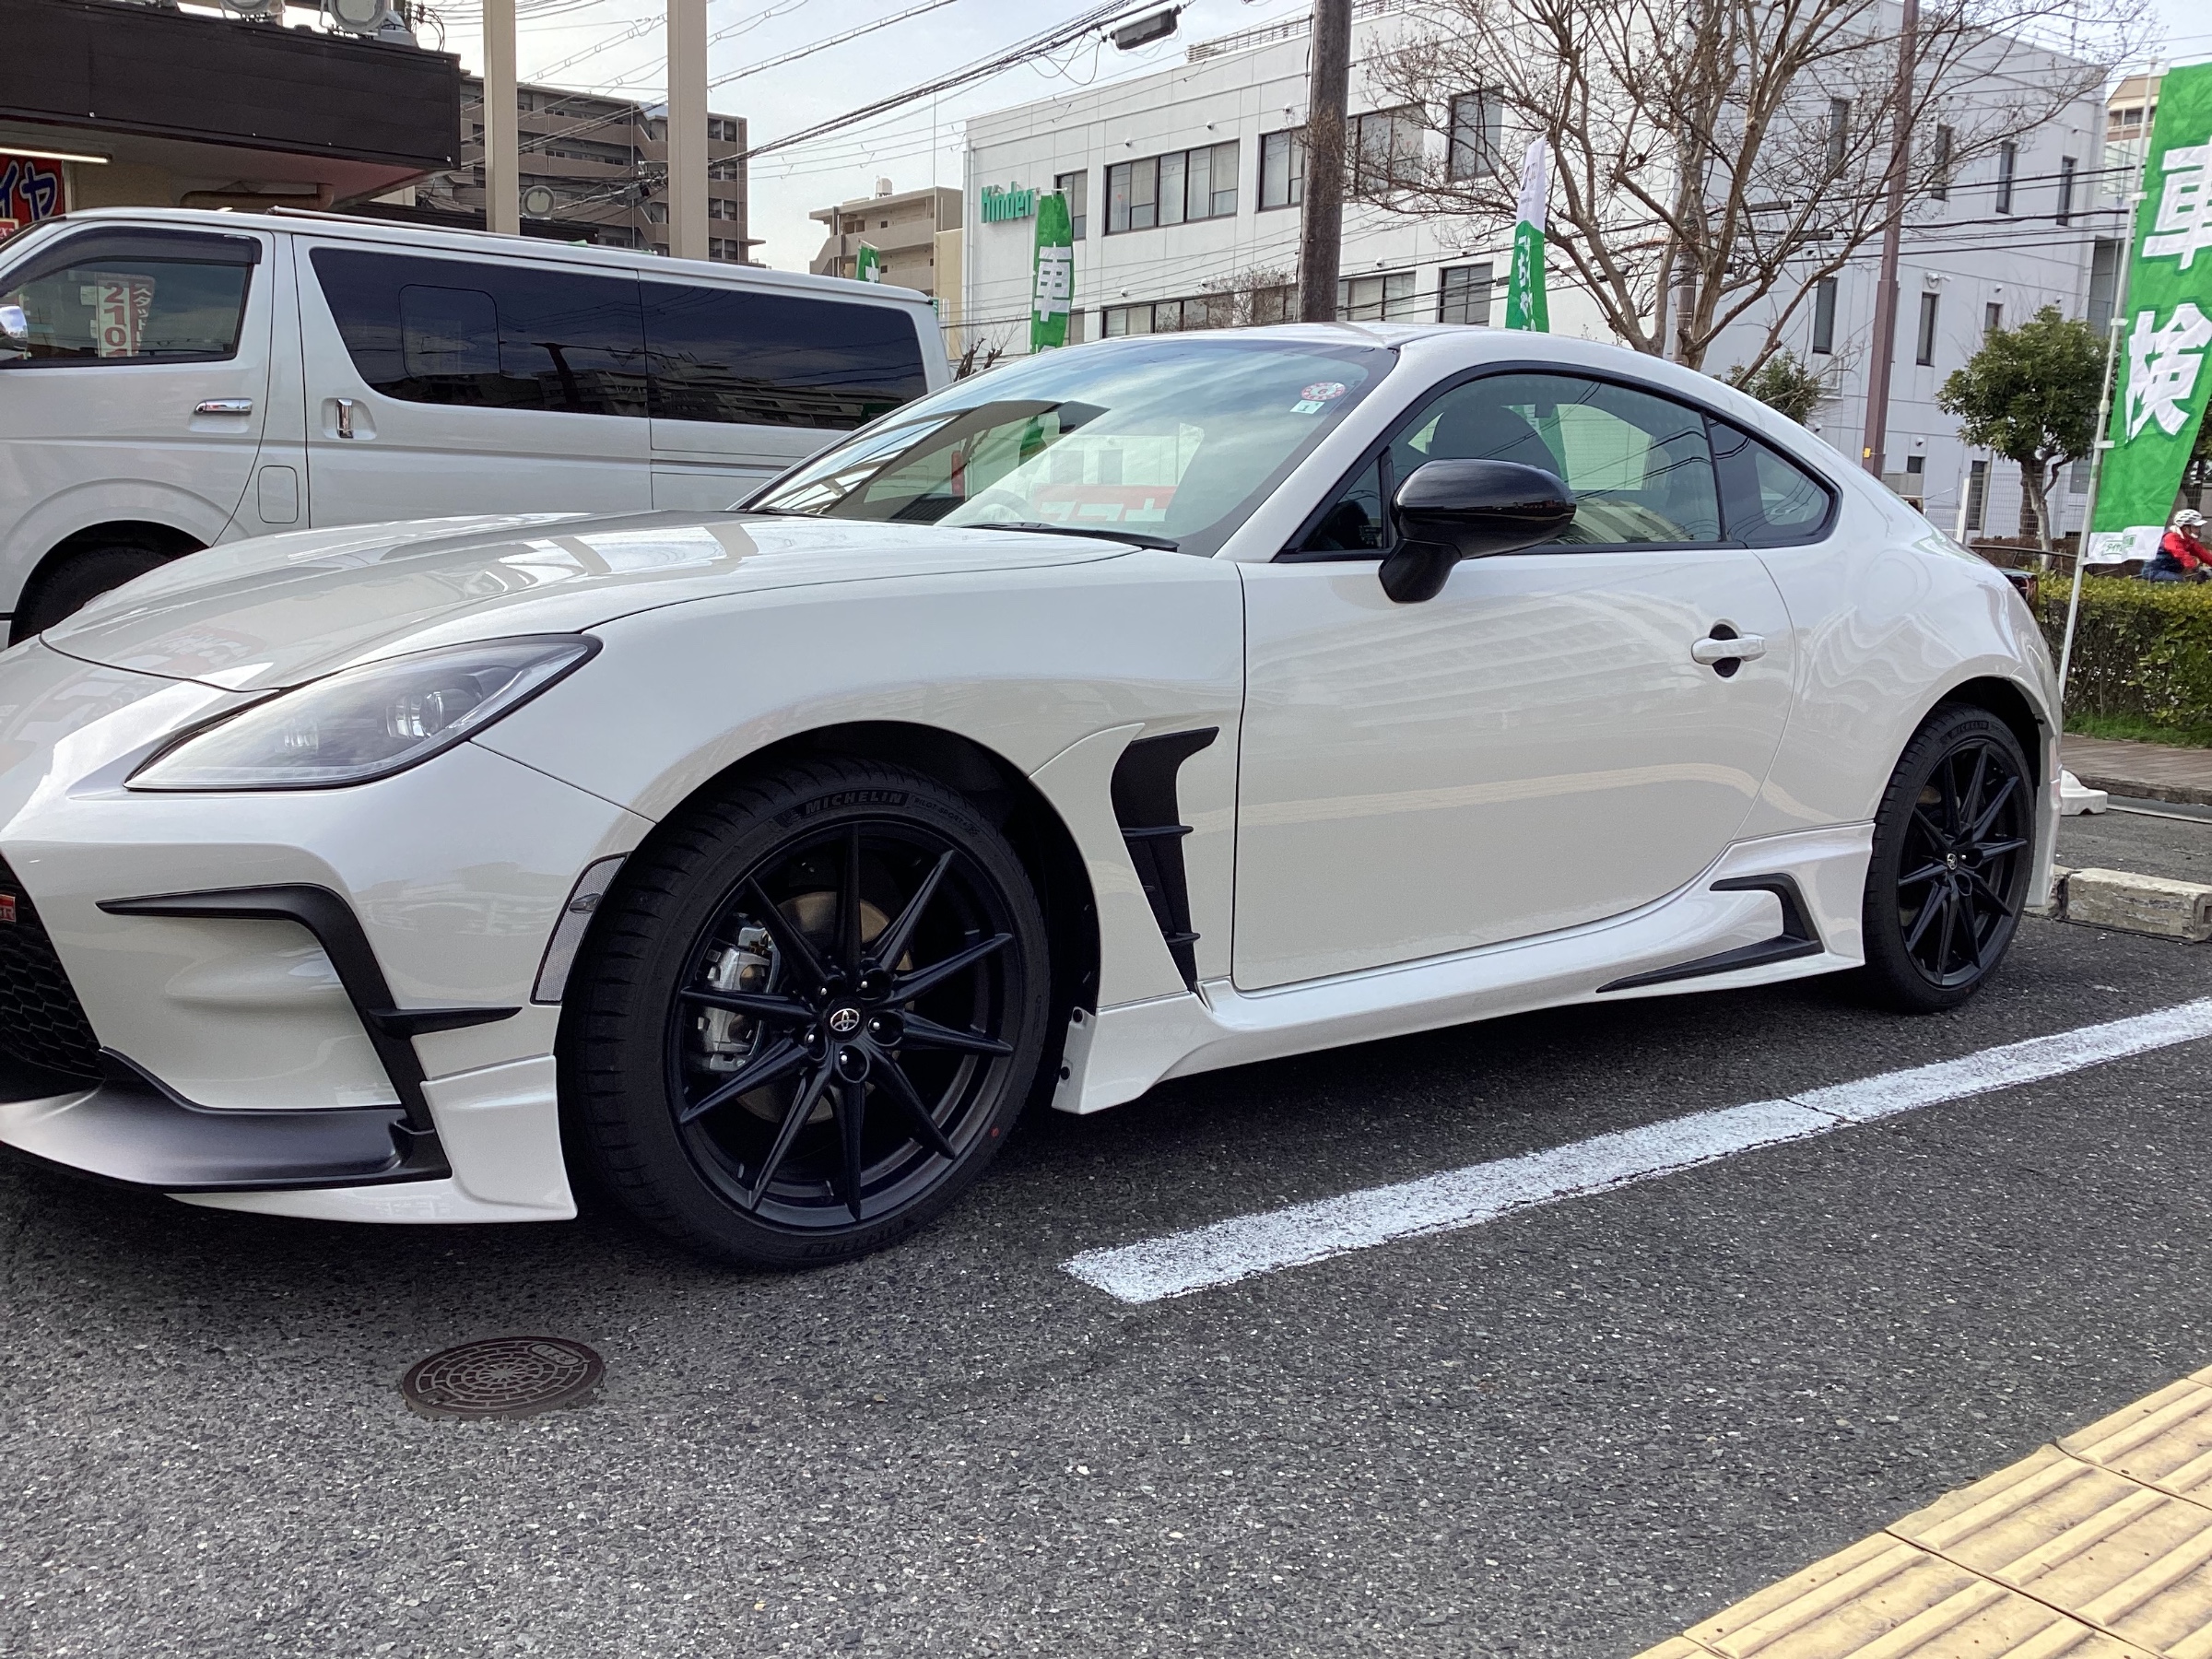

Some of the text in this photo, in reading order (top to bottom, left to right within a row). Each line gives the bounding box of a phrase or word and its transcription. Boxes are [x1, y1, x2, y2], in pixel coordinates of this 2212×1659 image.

[981, 181, 1035, 223] Kinden
[1033, 241, 1073, 353] 車
[2125, 135, 2212, 443] 車検
[805, 791, 903, 815] MICHELIN
[914, 797, 937, 809] PILOT
[938, 807, 964, 824] SPORT
